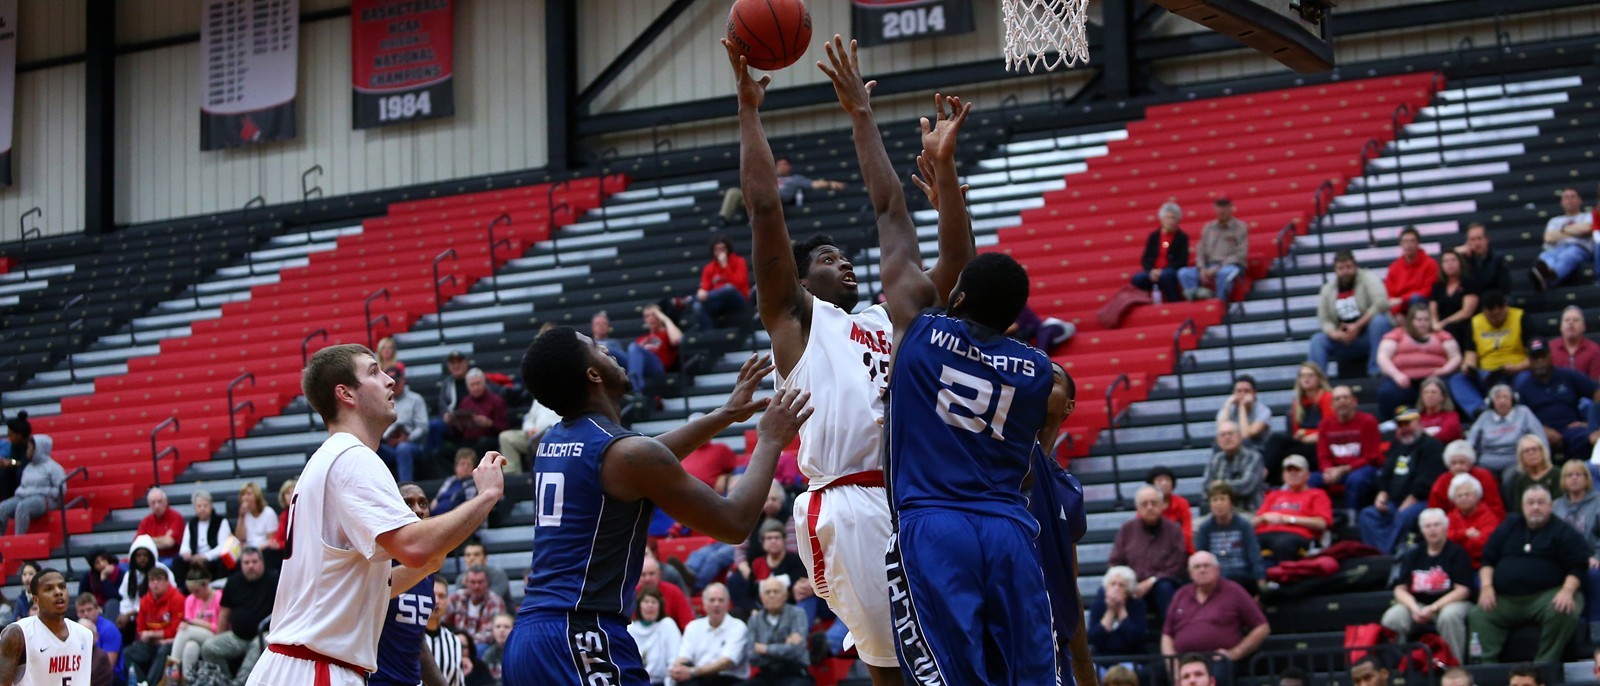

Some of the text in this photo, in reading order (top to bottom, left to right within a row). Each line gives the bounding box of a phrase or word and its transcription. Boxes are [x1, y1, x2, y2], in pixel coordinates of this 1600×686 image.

[388, 20, 421, 34] NCAA
[882, 5, 946, 38] 2014
[373, 48, 435, 68] NATIONAL
[368, 64, 441, 87] CHAMPIONS
[378, 90, 431, 121] 1984
[930, 328, 1035, 377] WILDCATS
[935, 364, 1016, 441] 21
[395, 593, 433, 626] 55
[49, 655, 82, 673] MULES
